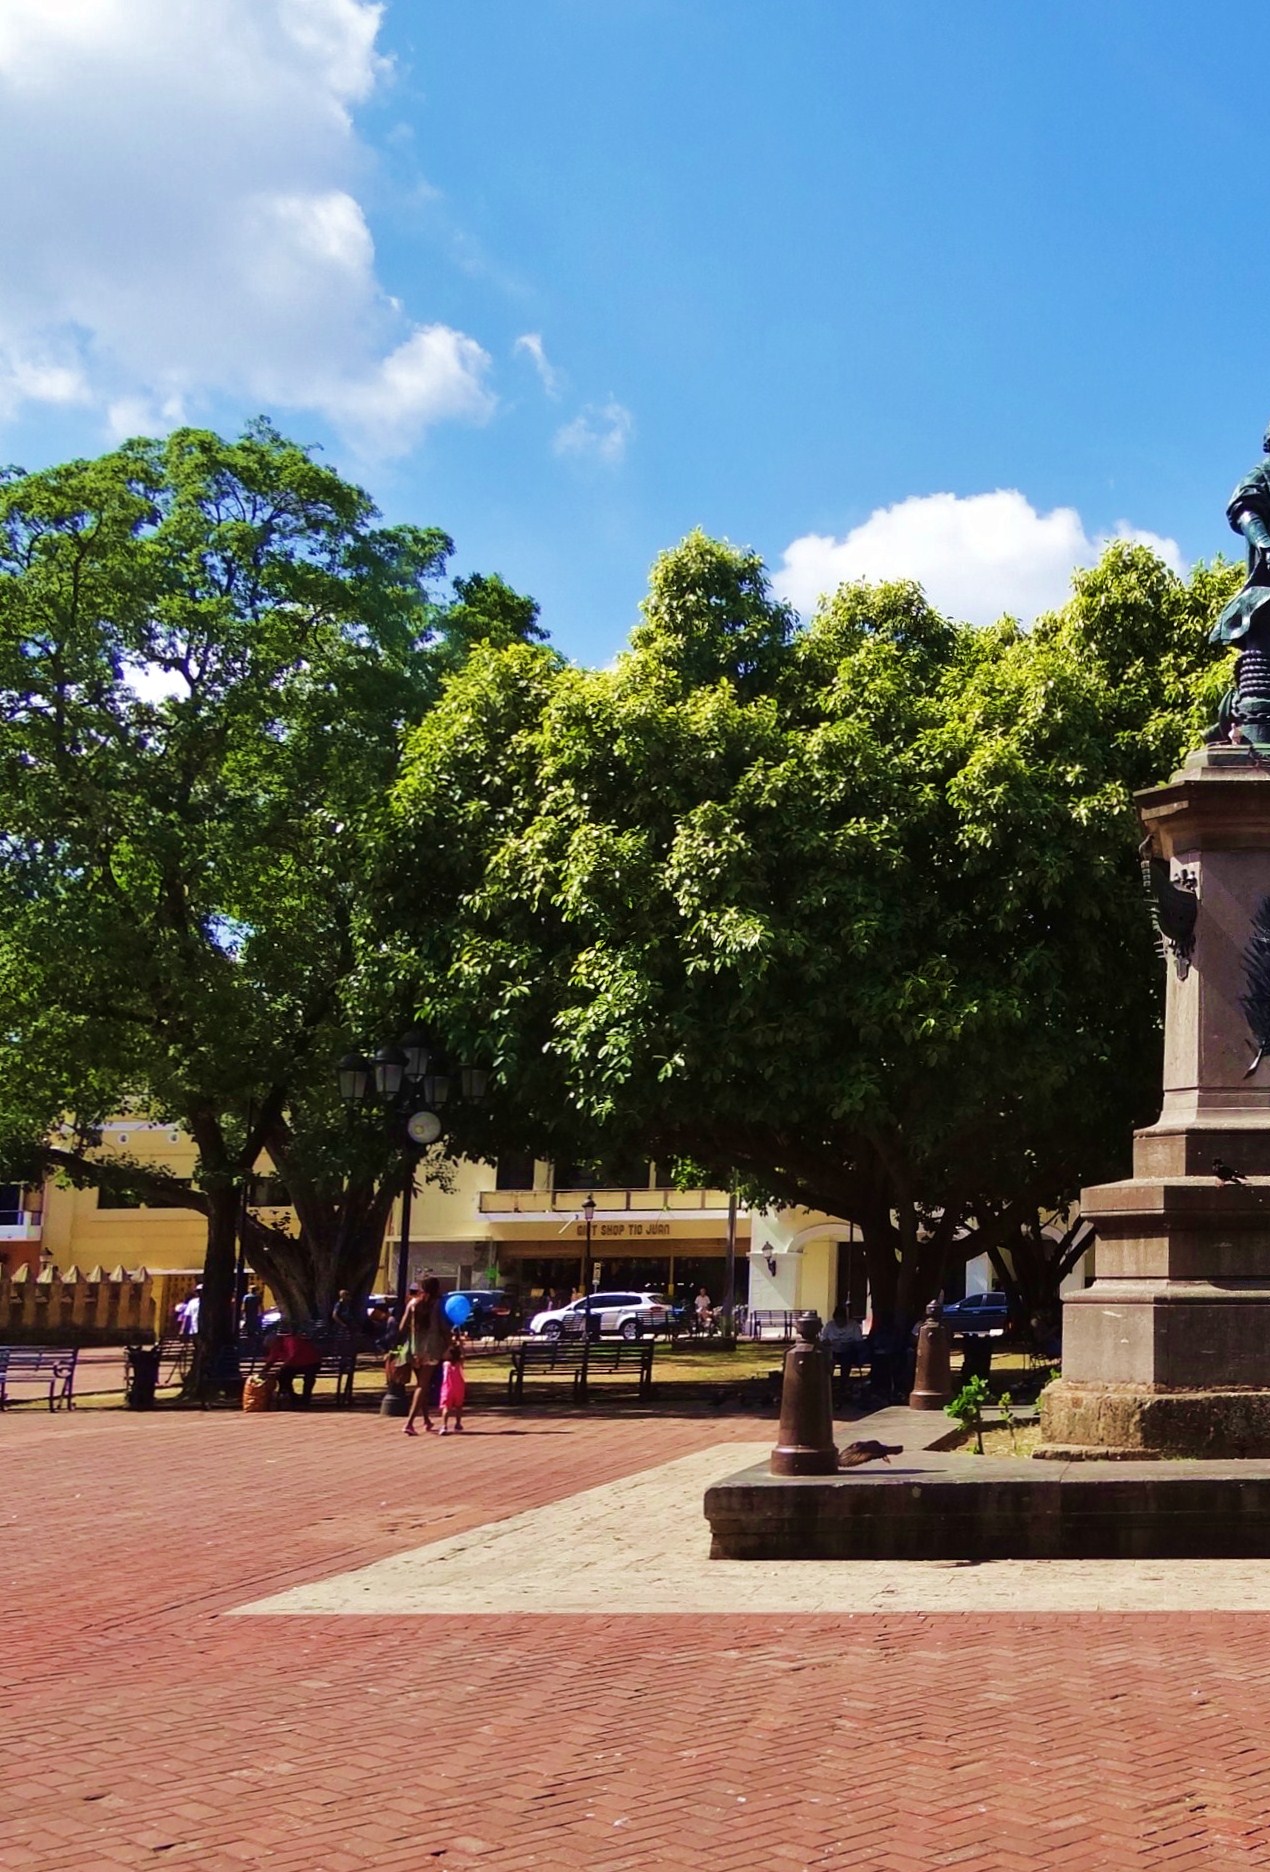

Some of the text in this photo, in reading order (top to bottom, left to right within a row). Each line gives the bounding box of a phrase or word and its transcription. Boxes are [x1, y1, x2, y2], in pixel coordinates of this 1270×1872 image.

[576, 1224, 670, 1236] GIT SHOP TIO JUAN
